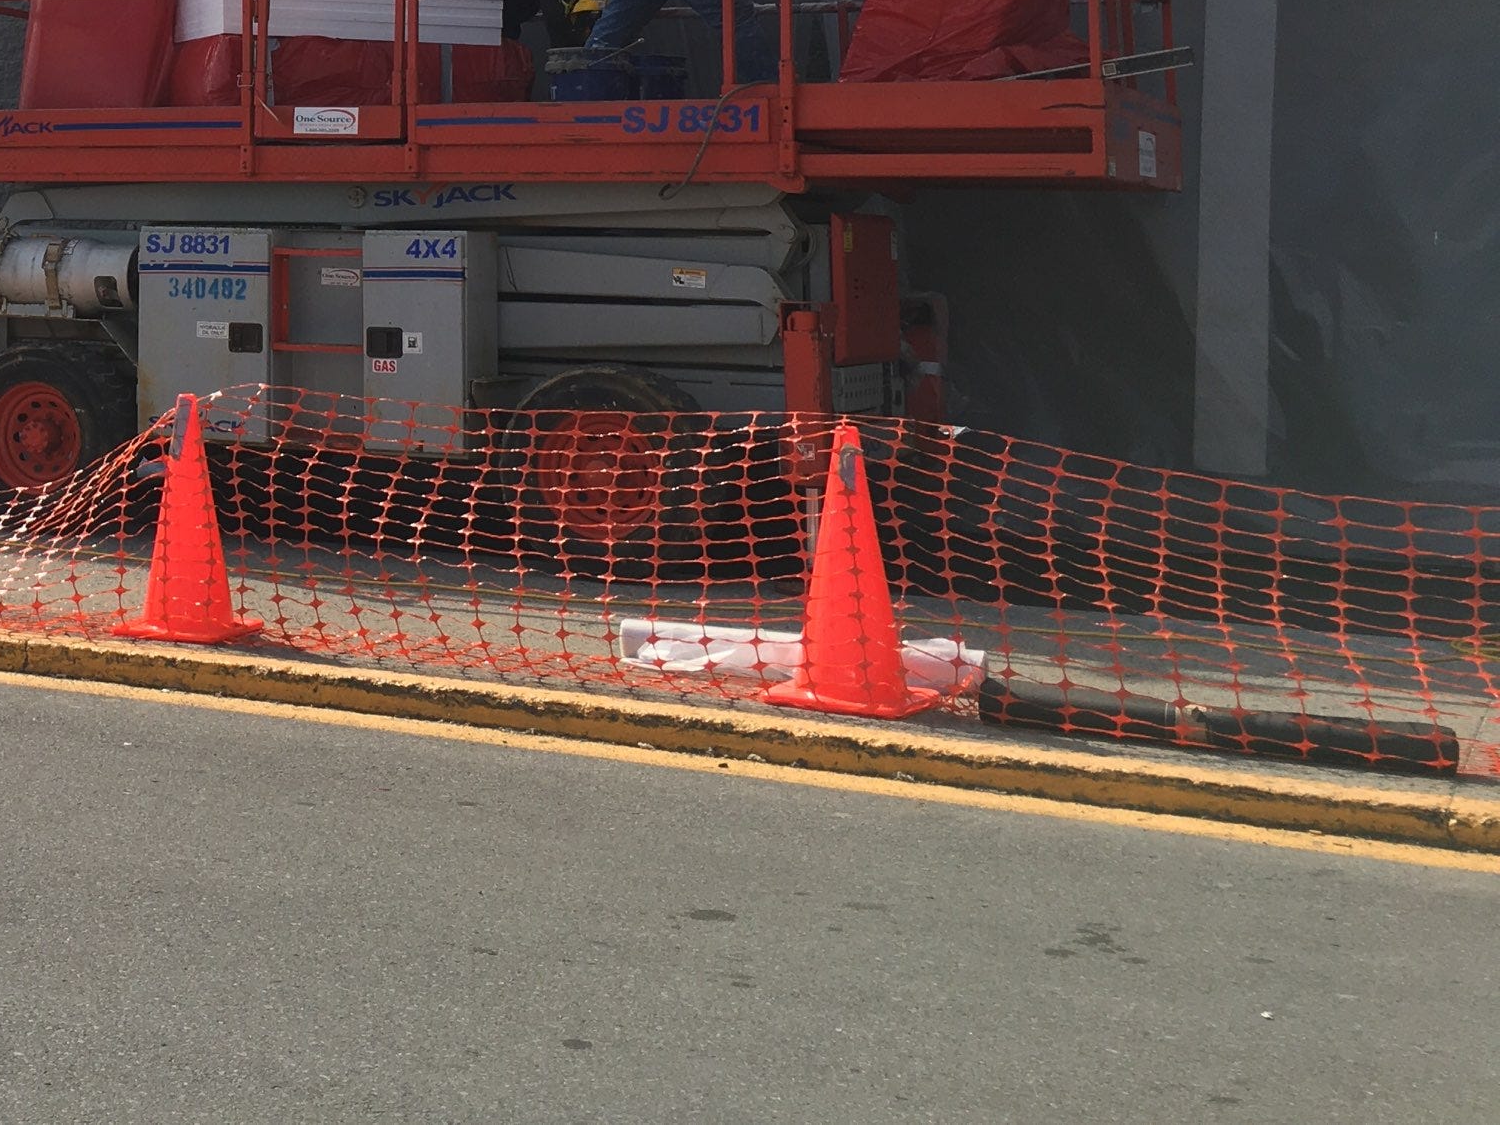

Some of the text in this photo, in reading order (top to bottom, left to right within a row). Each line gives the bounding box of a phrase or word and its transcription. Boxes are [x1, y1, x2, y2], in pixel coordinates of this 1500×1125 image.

[295, 114, 352, 123] One Source
[622, 104, 760, 133] SJ 8831
[372, 181, 517, 209] SKYJACK
[146, 234, 230, 255] SJ 8831
[405, 238, 457, 259] 4X4
[168, 276, 247, 301] 340482
[373, 360, 396, 372] GAS
